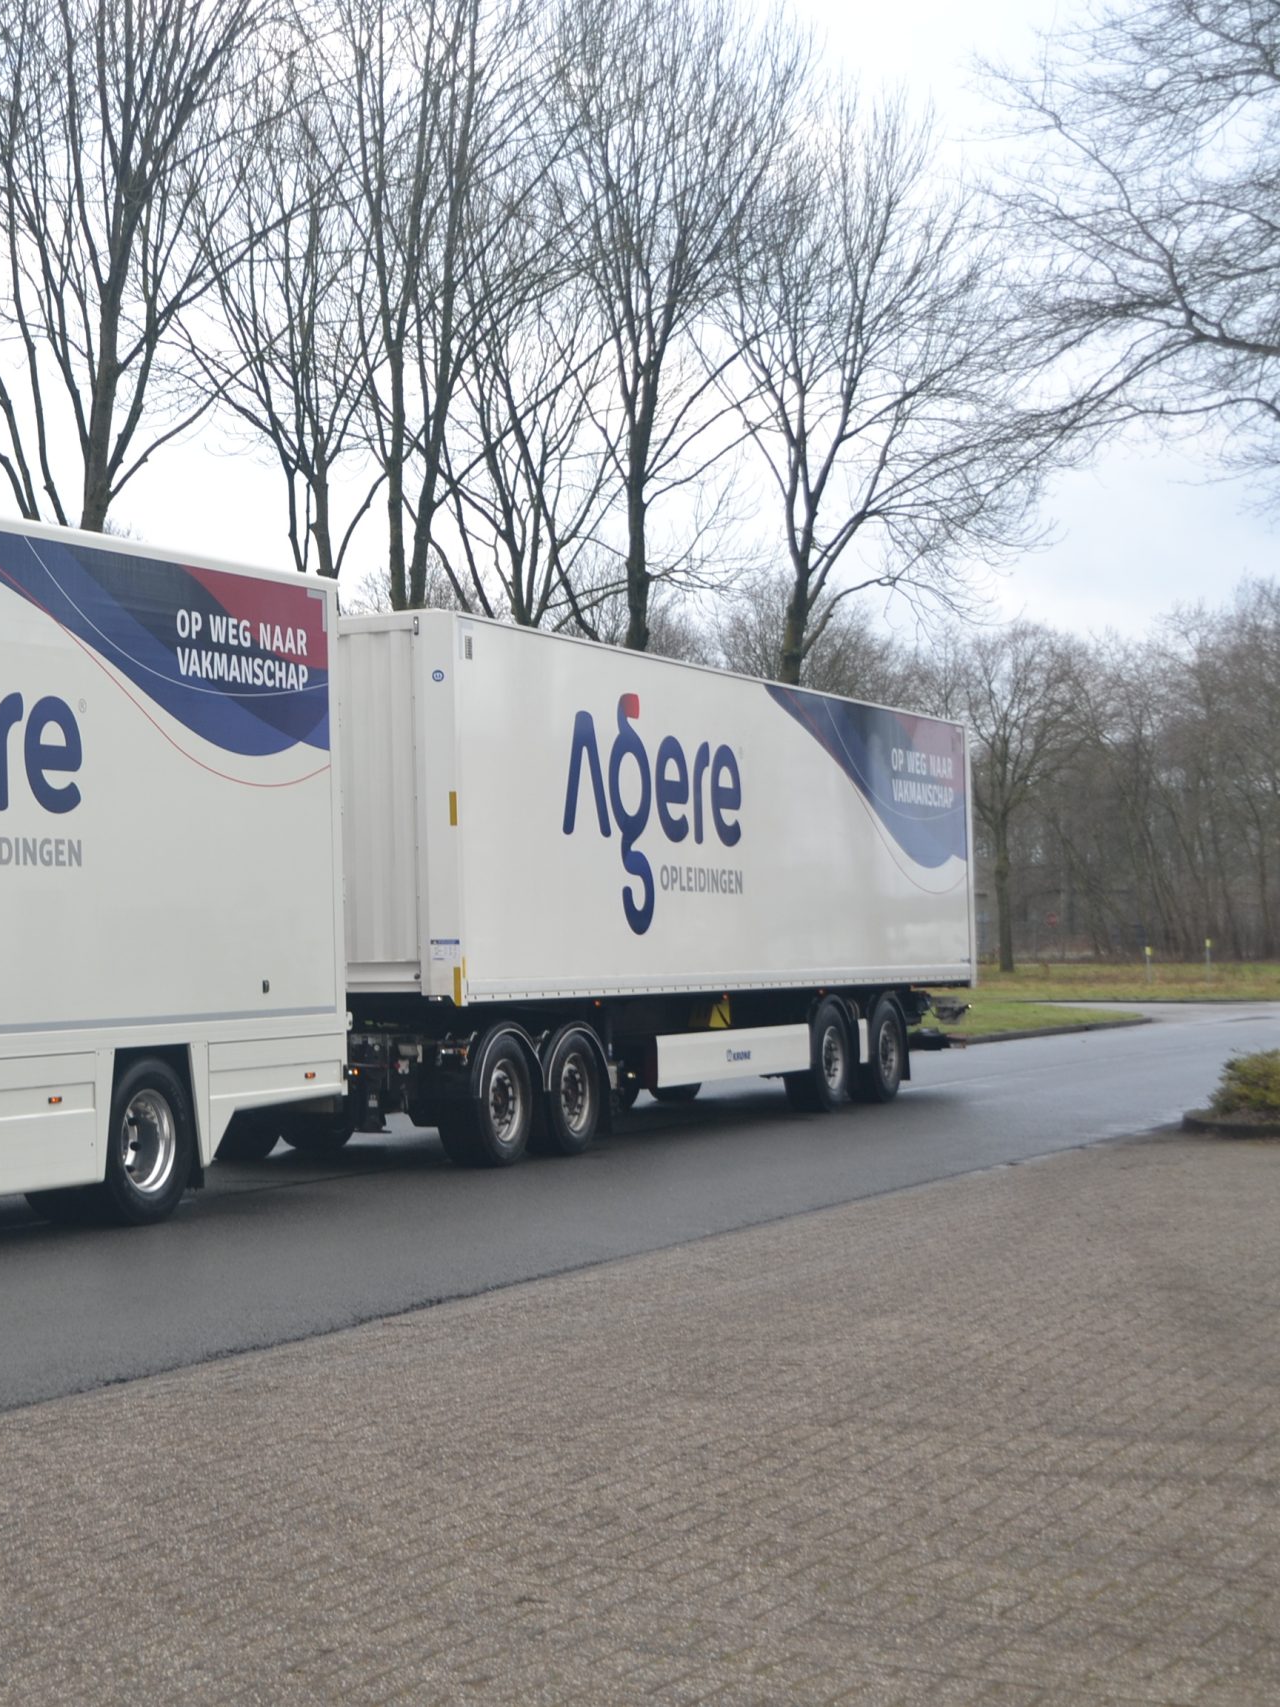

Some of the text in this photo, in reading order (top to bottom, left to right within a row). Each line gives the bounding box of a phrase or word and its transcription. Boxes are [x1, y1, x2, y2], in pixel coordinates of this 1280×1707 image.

[176, 609, 308, 656] OP WEG NAAR
[176, 646, 309, 691] VAKMANSCHAP
[891, 748, 953, 779] OP WEG NAAR
[892, 778, 954, 808] VAKMANSCHAP
[562, 693, 742, 936] Agere
[660, 864, 743, 894] OPLEIDINGEN
